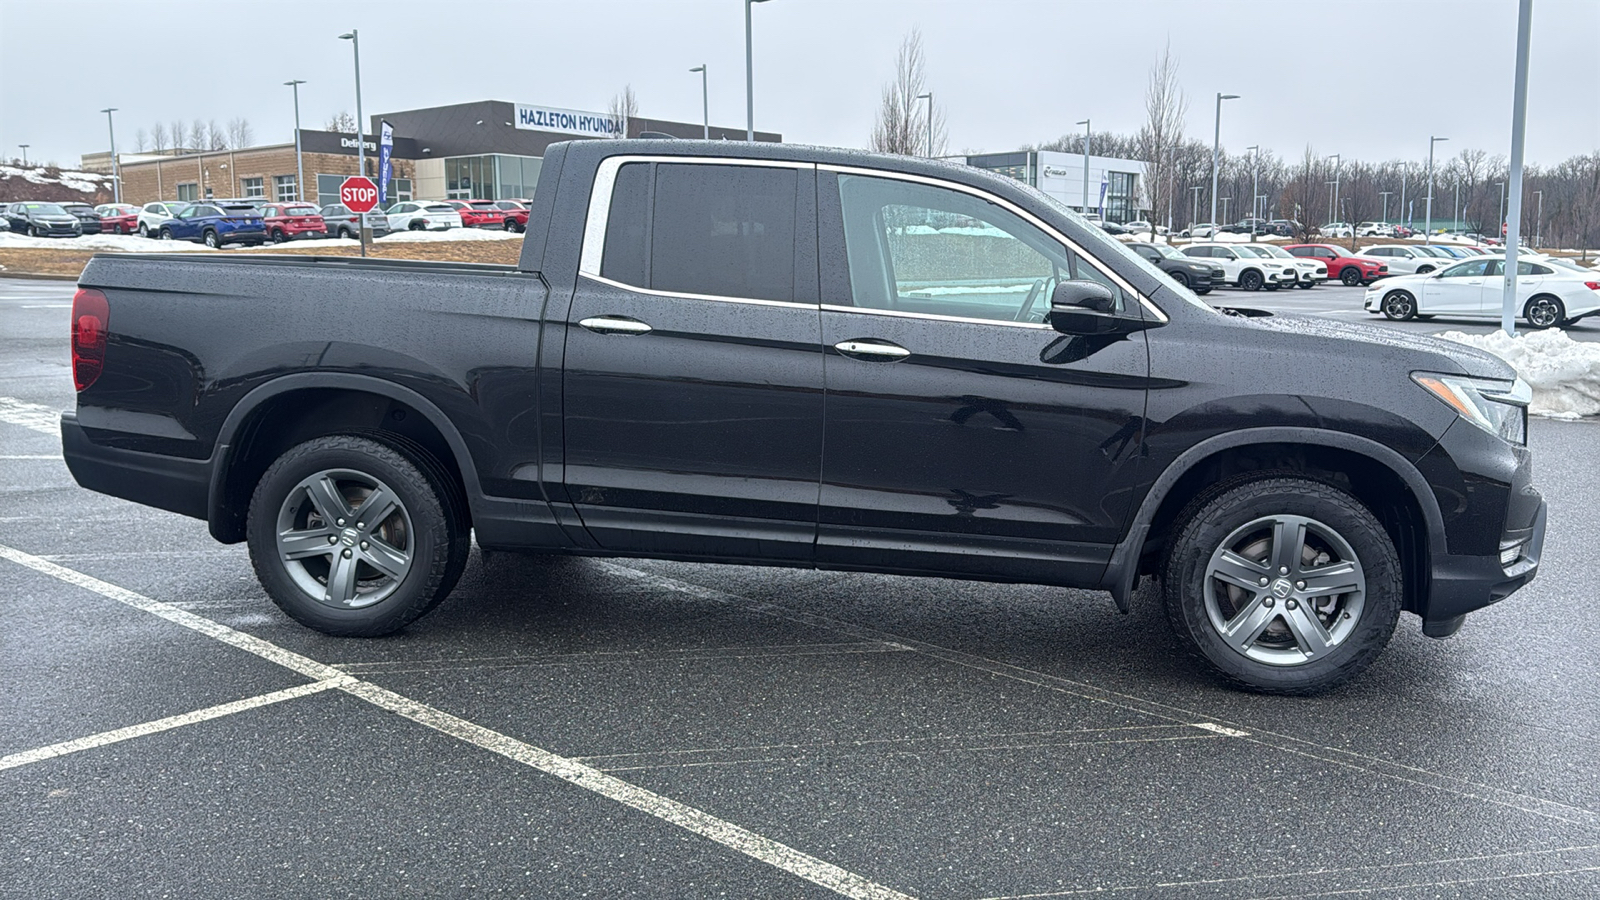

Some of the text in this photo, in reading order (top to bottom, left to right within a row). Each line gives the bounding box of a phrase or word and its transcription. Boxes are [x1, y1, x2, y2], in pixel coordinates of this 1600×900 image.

[520, 108, 624, 135] HAZLETON HYUNDAI
[341, 138, 376, 151] Deliery
[343, 187, 376, 202] STOP
